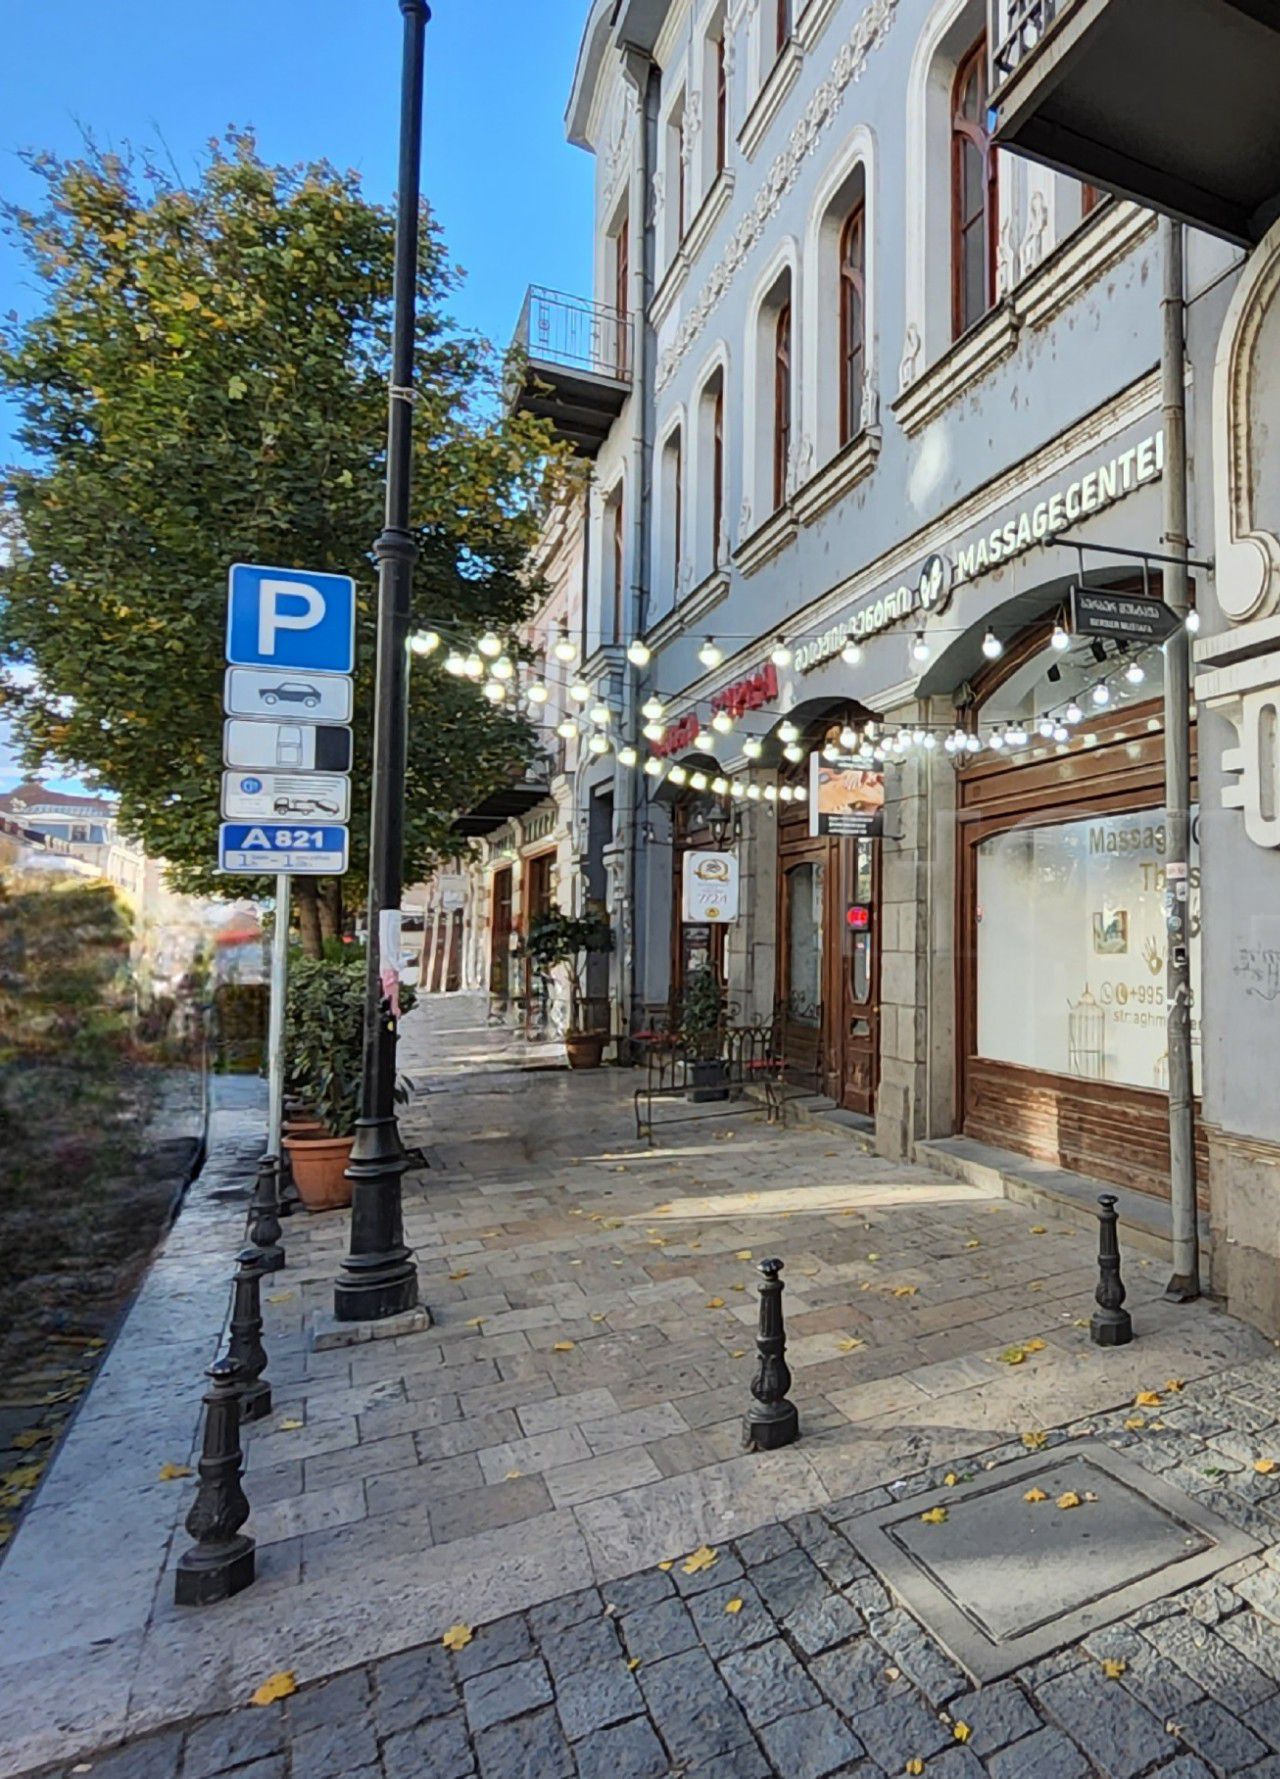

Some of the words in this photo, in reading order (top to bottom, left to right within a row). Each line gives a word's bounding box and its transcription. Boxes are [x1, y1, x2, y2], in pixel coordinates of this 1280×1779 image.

[957, 492, 1064, 582] MASSAGE
[257, 578, 326, 656] P
[241, 828, 272, 849] A
[275, 830, 324, 849] 821
[1089, 824, 1168, 855] Massag
